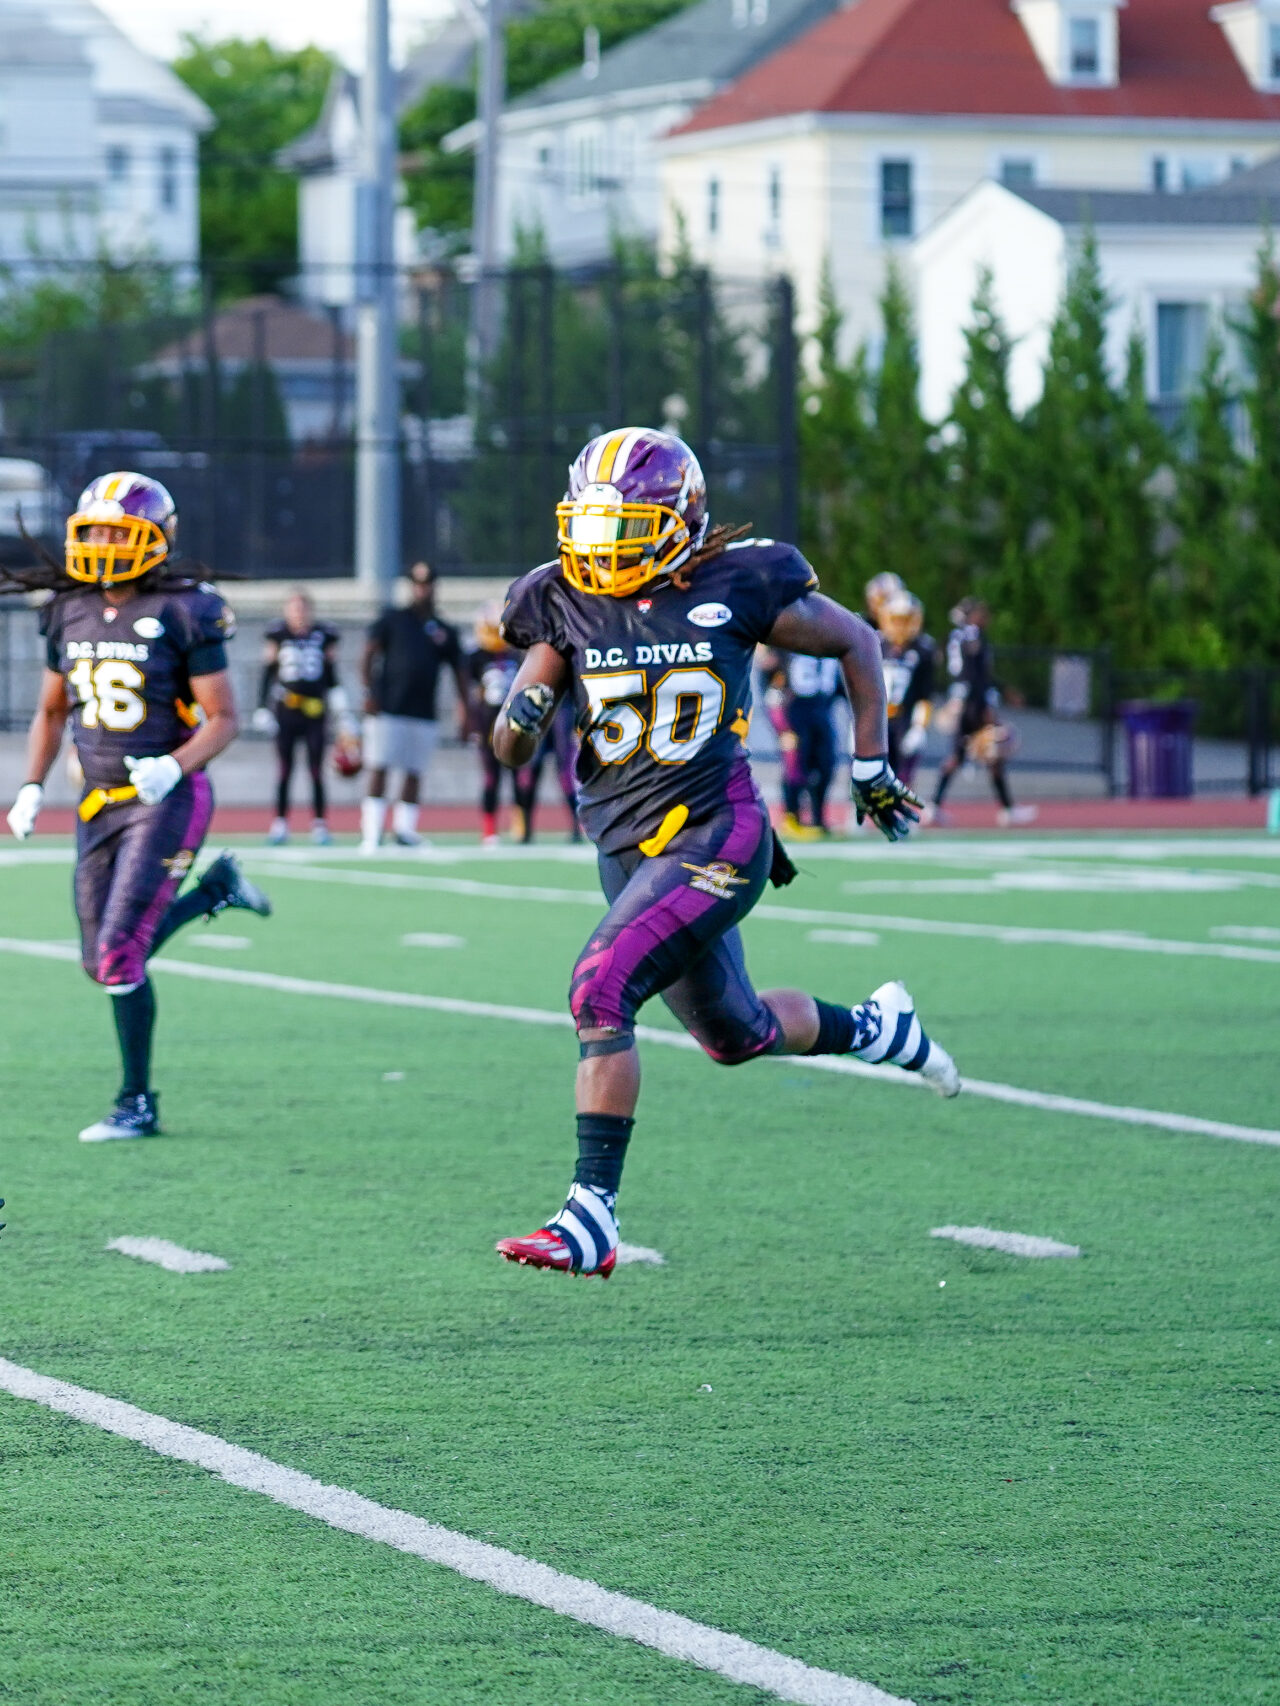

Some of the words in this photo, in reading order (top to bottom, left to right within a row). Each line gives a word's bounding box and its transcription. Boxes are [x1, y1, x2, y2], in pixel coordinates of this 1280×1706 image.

[585, 647, 628, 669] D.C.
[635, 641, 714, 665] DIVAS
[67, 658, 148, 732] 16
[580, 667, 726, 767] 50
